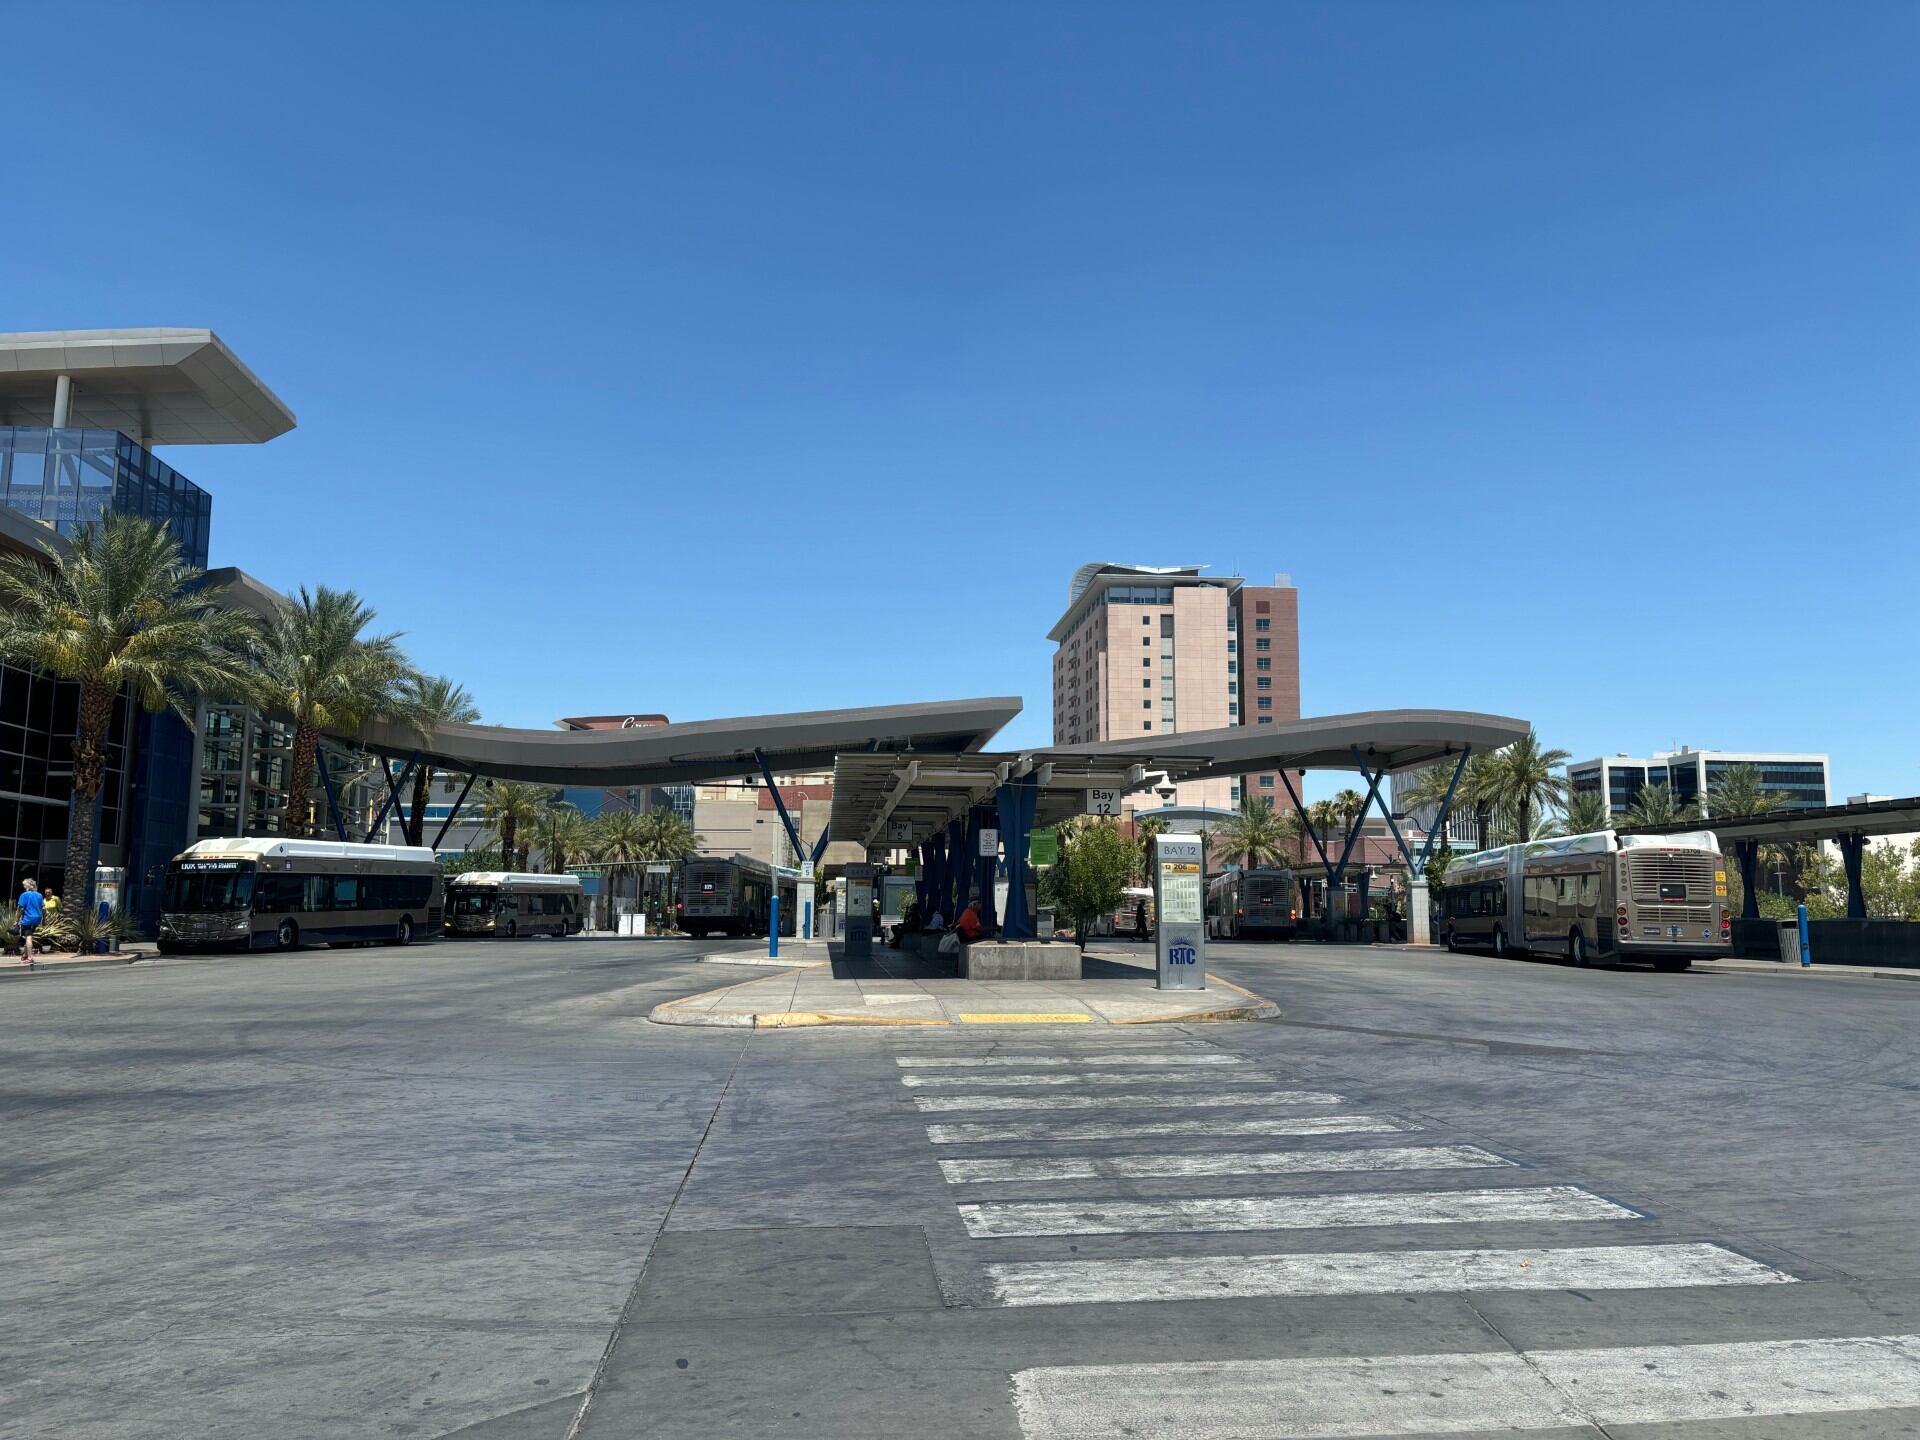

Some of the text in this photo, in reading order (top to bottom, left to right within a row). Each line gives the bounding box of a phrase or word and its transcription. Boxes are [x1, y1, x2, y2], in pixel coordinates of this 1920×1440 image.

[1092, 790, 1114, 801] Bay
[1096, 803, 1111, 814] 12
[891, 823, 908, 831] Bay
[897, 832, 903, 840] 5
[1164, 846, 1196, 855] BAY 12
[1169, 947, 1196, 965] RTC
